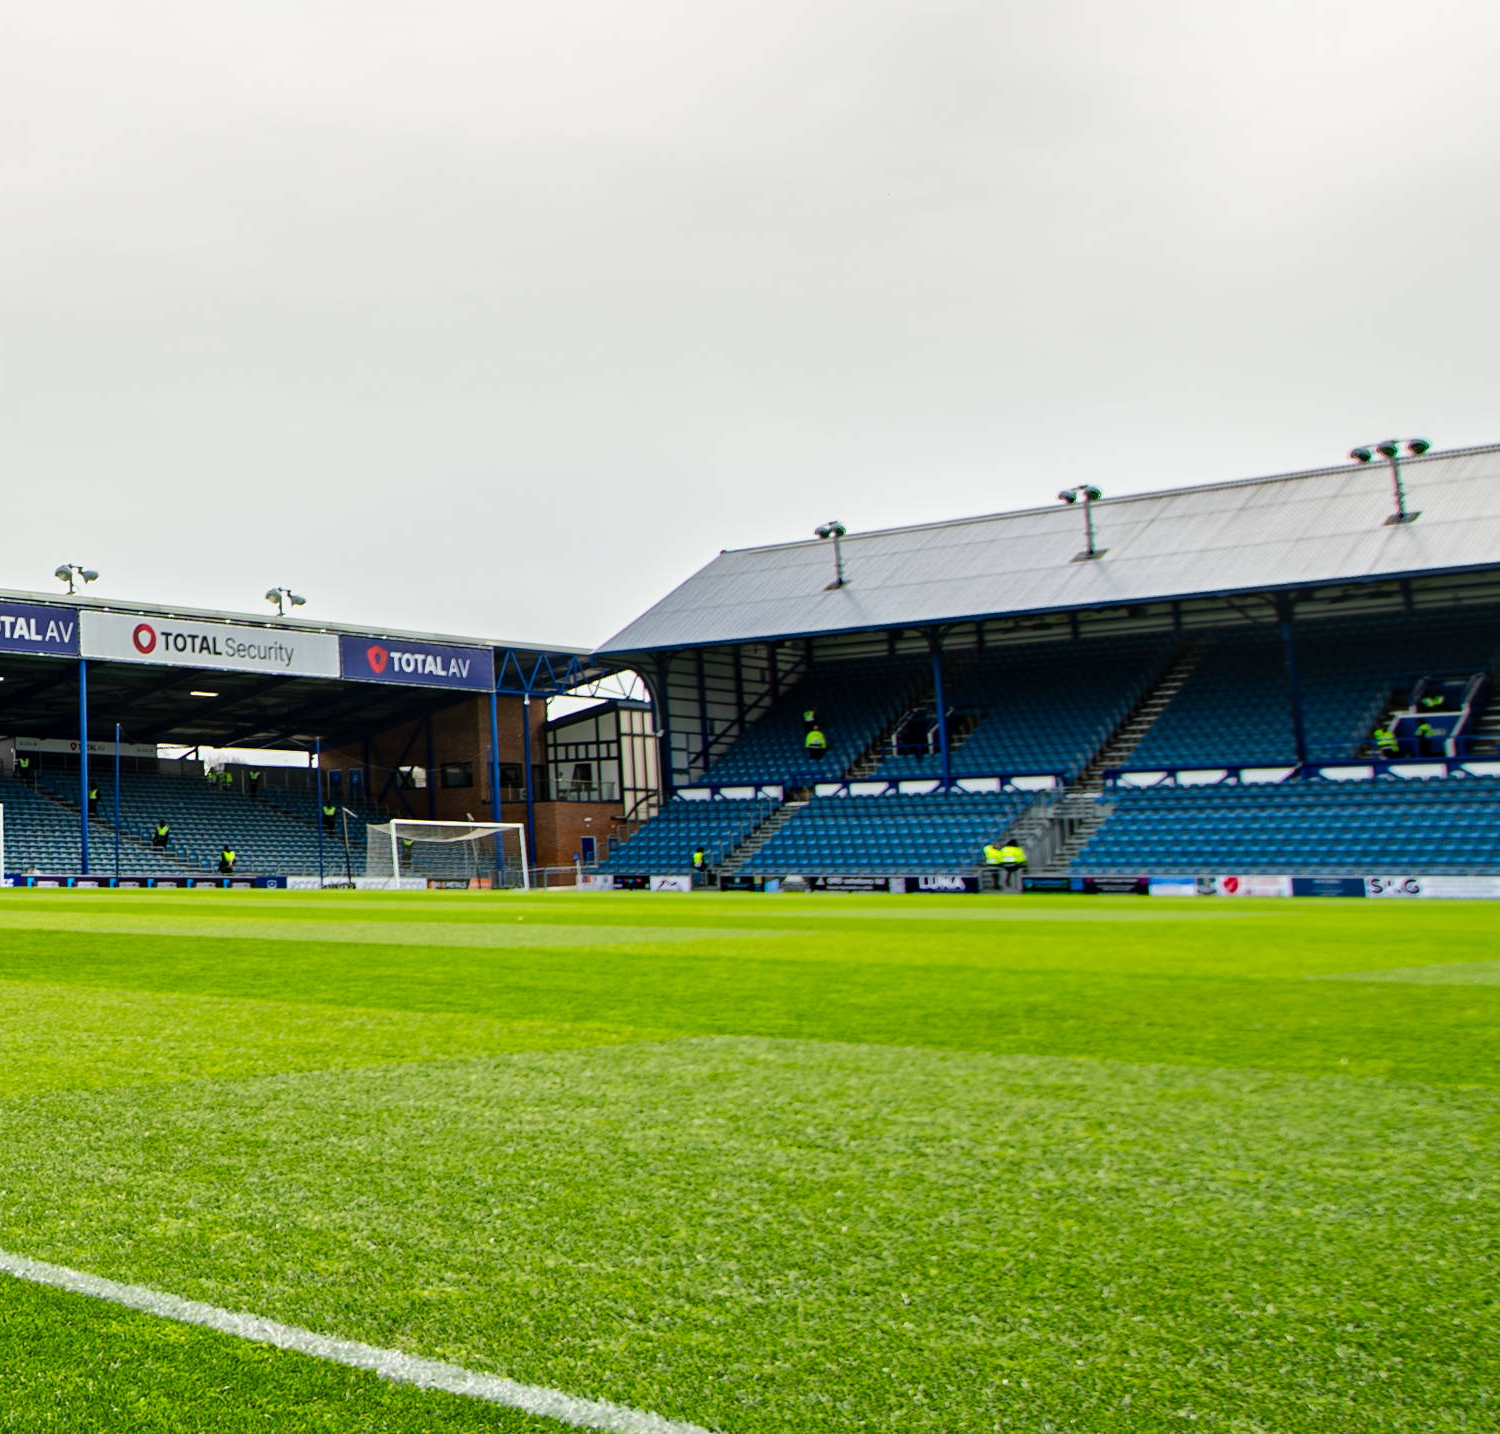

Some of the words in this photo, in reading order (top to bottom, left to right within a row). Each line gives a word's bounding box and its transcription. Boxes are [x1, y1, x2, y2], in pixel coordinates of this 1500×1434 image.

[45, 622, 74, 643] AV
[160, 631, 222, 655] TOTAL
[225, 637, 295, 666] Security
[389, 651, 447, 675] TOTAL
[448, 658, 471, 679] AV
